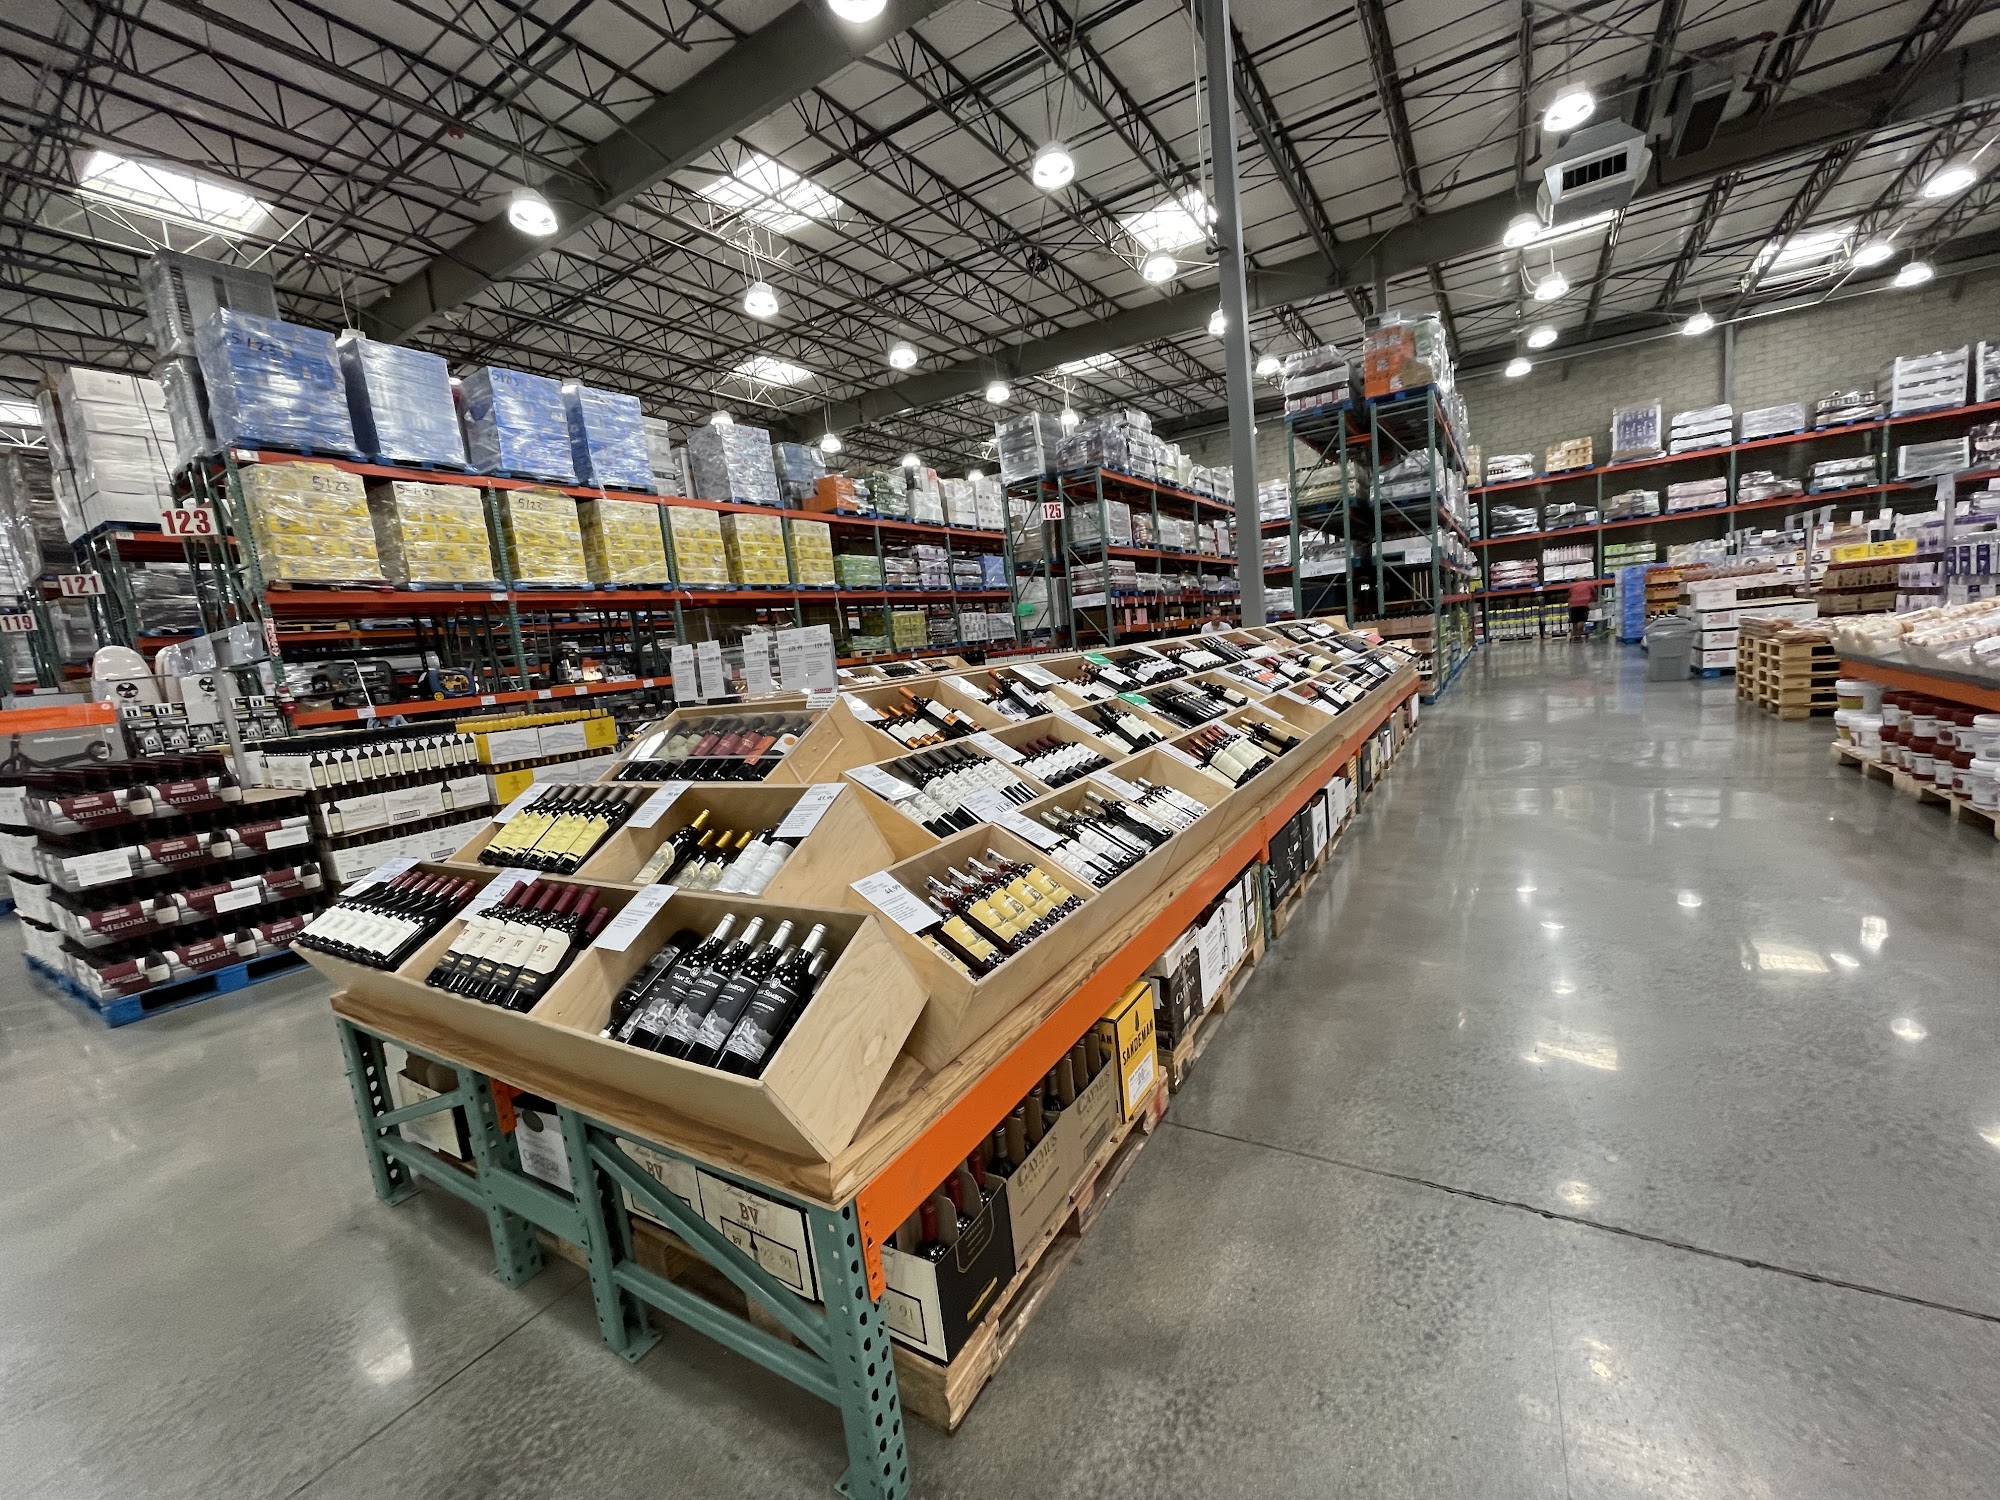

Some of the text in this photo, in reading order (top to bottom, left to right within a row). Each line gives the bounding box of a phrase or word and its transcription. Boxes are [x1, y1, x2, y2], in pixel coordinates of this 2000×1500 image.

[1043, 503, 1062, 519] 125
[161, 509, 211, 534] 123
[62, 575, 100, 595] 121
[1, 614, 33, 631] 119
[169, 793, 215, 805] MEIOMI
[72, 805, 122, 821] MEIOMI
[241, 823, 278, 835] MEIOMI
[159, 849, 205, 864] MEIOMI
[188, 885, 226, 899] MEIOMI
[100, 917, 149, 934] MEIOMI
[187, 950, 231, 967] MEIOMI
[764, 988, 788, 1005] SIMEON
[1122, 1018, 1154, 1066] SANDEMAN
[645, 1160, 663, 1181] BV
[737, 1201, 760, 1226] BV
[732, 1235, 742, 1247] BV
[899, 1305, 914, 1321] 91
